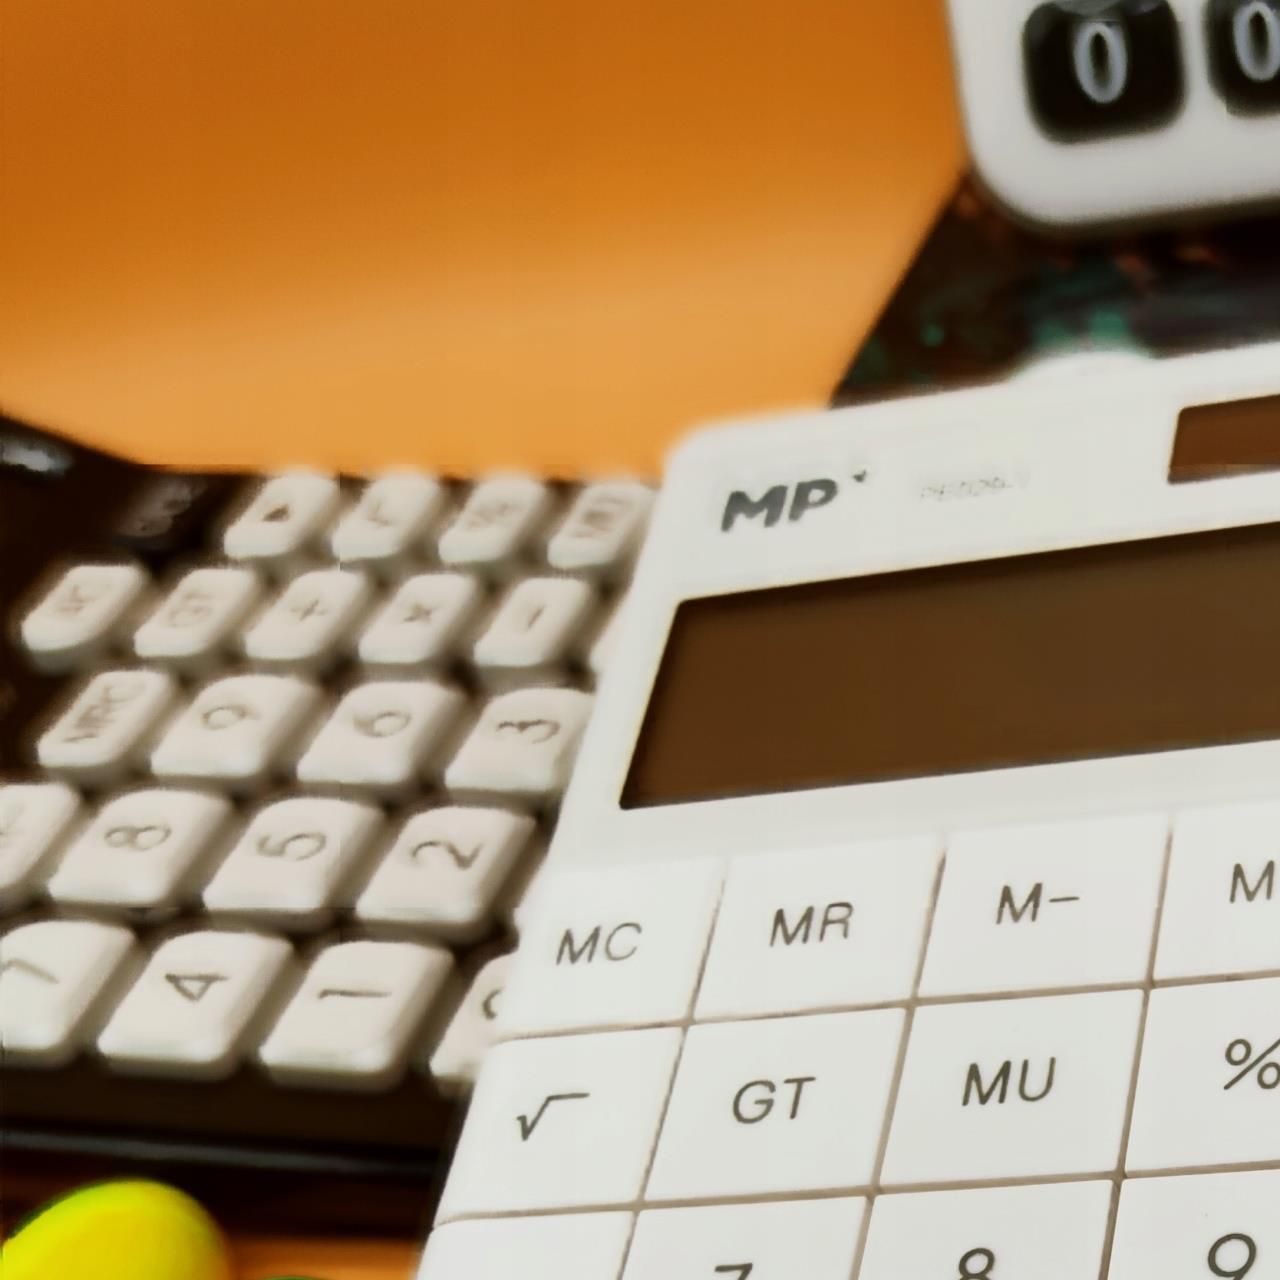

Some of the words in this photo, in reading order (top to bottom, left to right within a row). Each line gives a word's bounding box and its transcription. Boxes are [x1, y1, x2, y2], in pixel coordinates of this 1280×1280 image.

[1072, 21, 1128, 103] 0
[721, 478, 839, 533] MP
[495, 718, 561, 745] 3
[103, 824, 172, 852] 8
[410, 838, 484, 870] 2
[769, 901, 855, 948] MR
[995, 881, 1081, 925] M-
[555, 921, 643, 971] MC
[164, 972, 231, 1002] 4
[731, 1075, 817, 1125] GT
[961, 1056, 1057, 1107] MU
